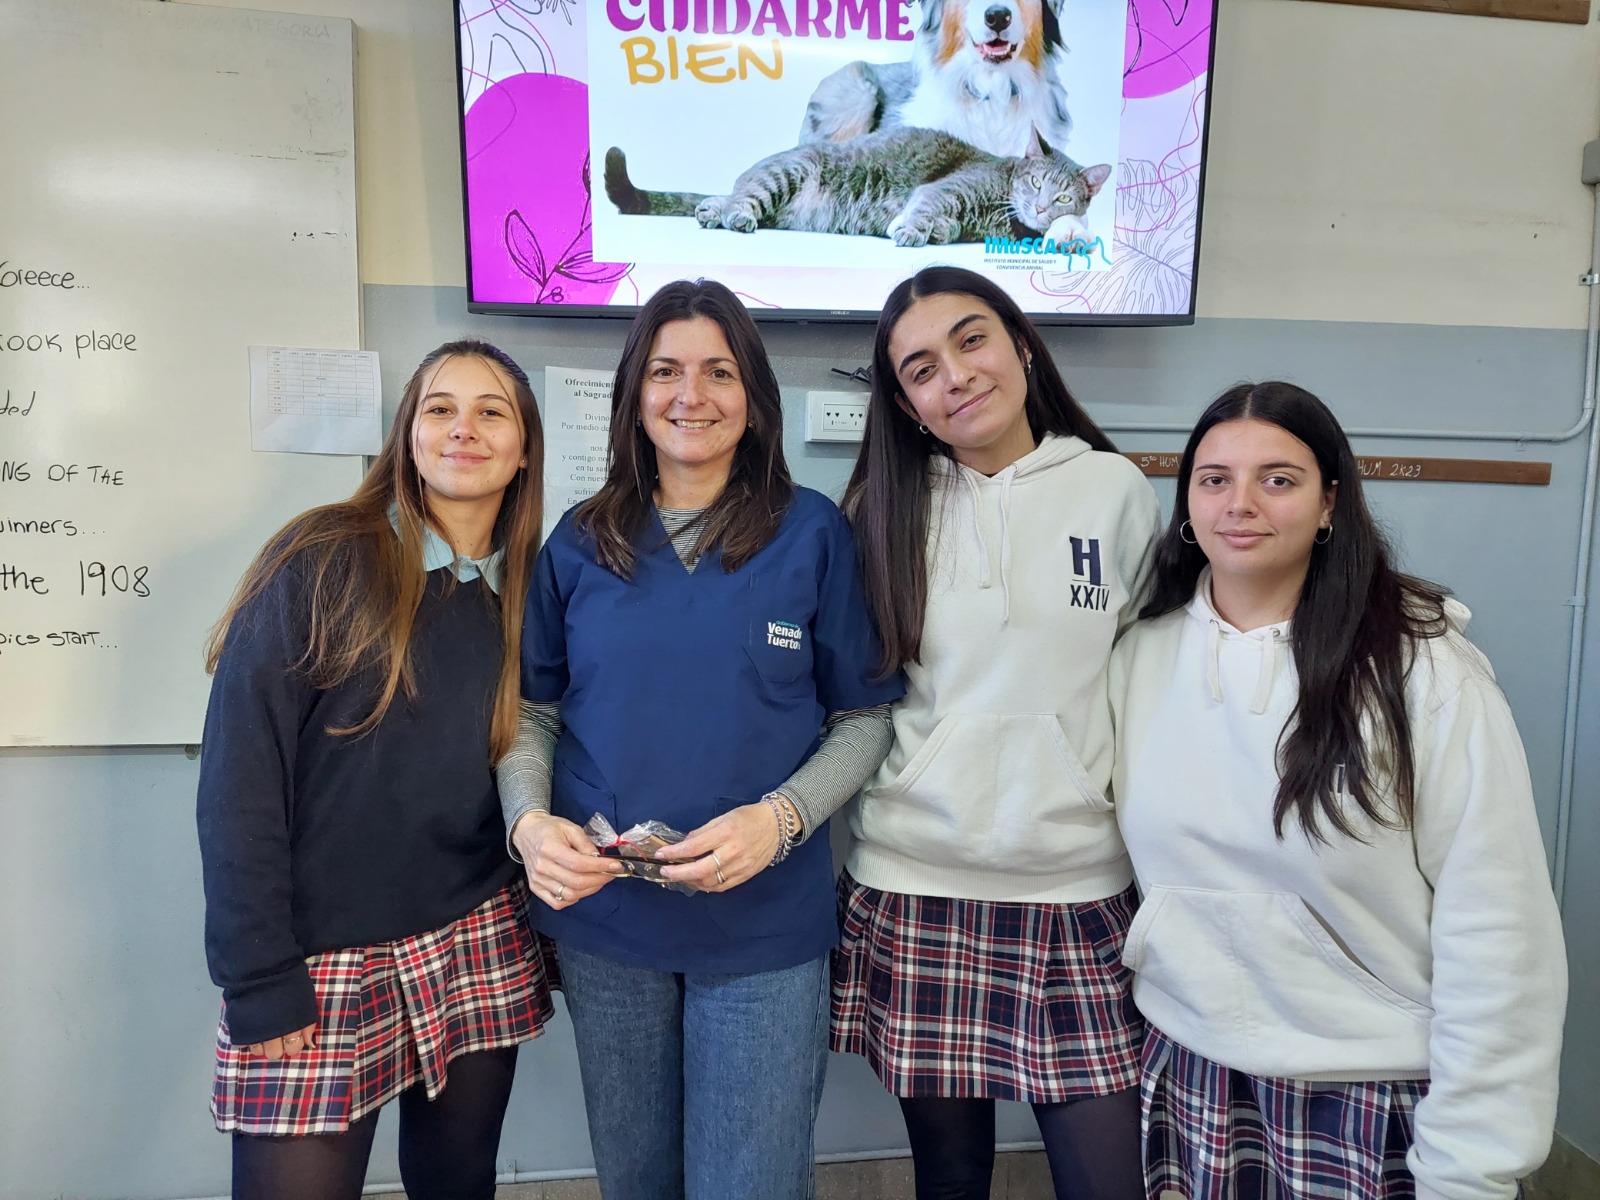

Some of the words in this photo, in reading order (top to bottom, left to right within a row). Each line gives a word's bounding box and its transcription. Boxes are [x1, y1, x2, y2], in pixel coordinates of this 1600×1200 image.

[606, 0, 915, 41] CUIDARME
[620, 35, 783, 85] BIEN
[75, 330, 137, 359] place
[565, 378, 614, 388] Ofrecimient
[583, 391, 612, 399] Sagrad
[584, 413, 610, 421] Divino
[561, 422, 574, 430] Por
[562, 454, 567, 462] y
[568, 454, 596, 462] contigo
[1159, 455, 1180, 469] HUM
[48, 464, 78, 482] OF
[570, 474, 586, 482] Con
[1069, 535, 1102, 587] H
[0, 563, 50, 595] the
[80, 560, 151, 598] 1908
[1070, 584, 1110, 612] XXIV
